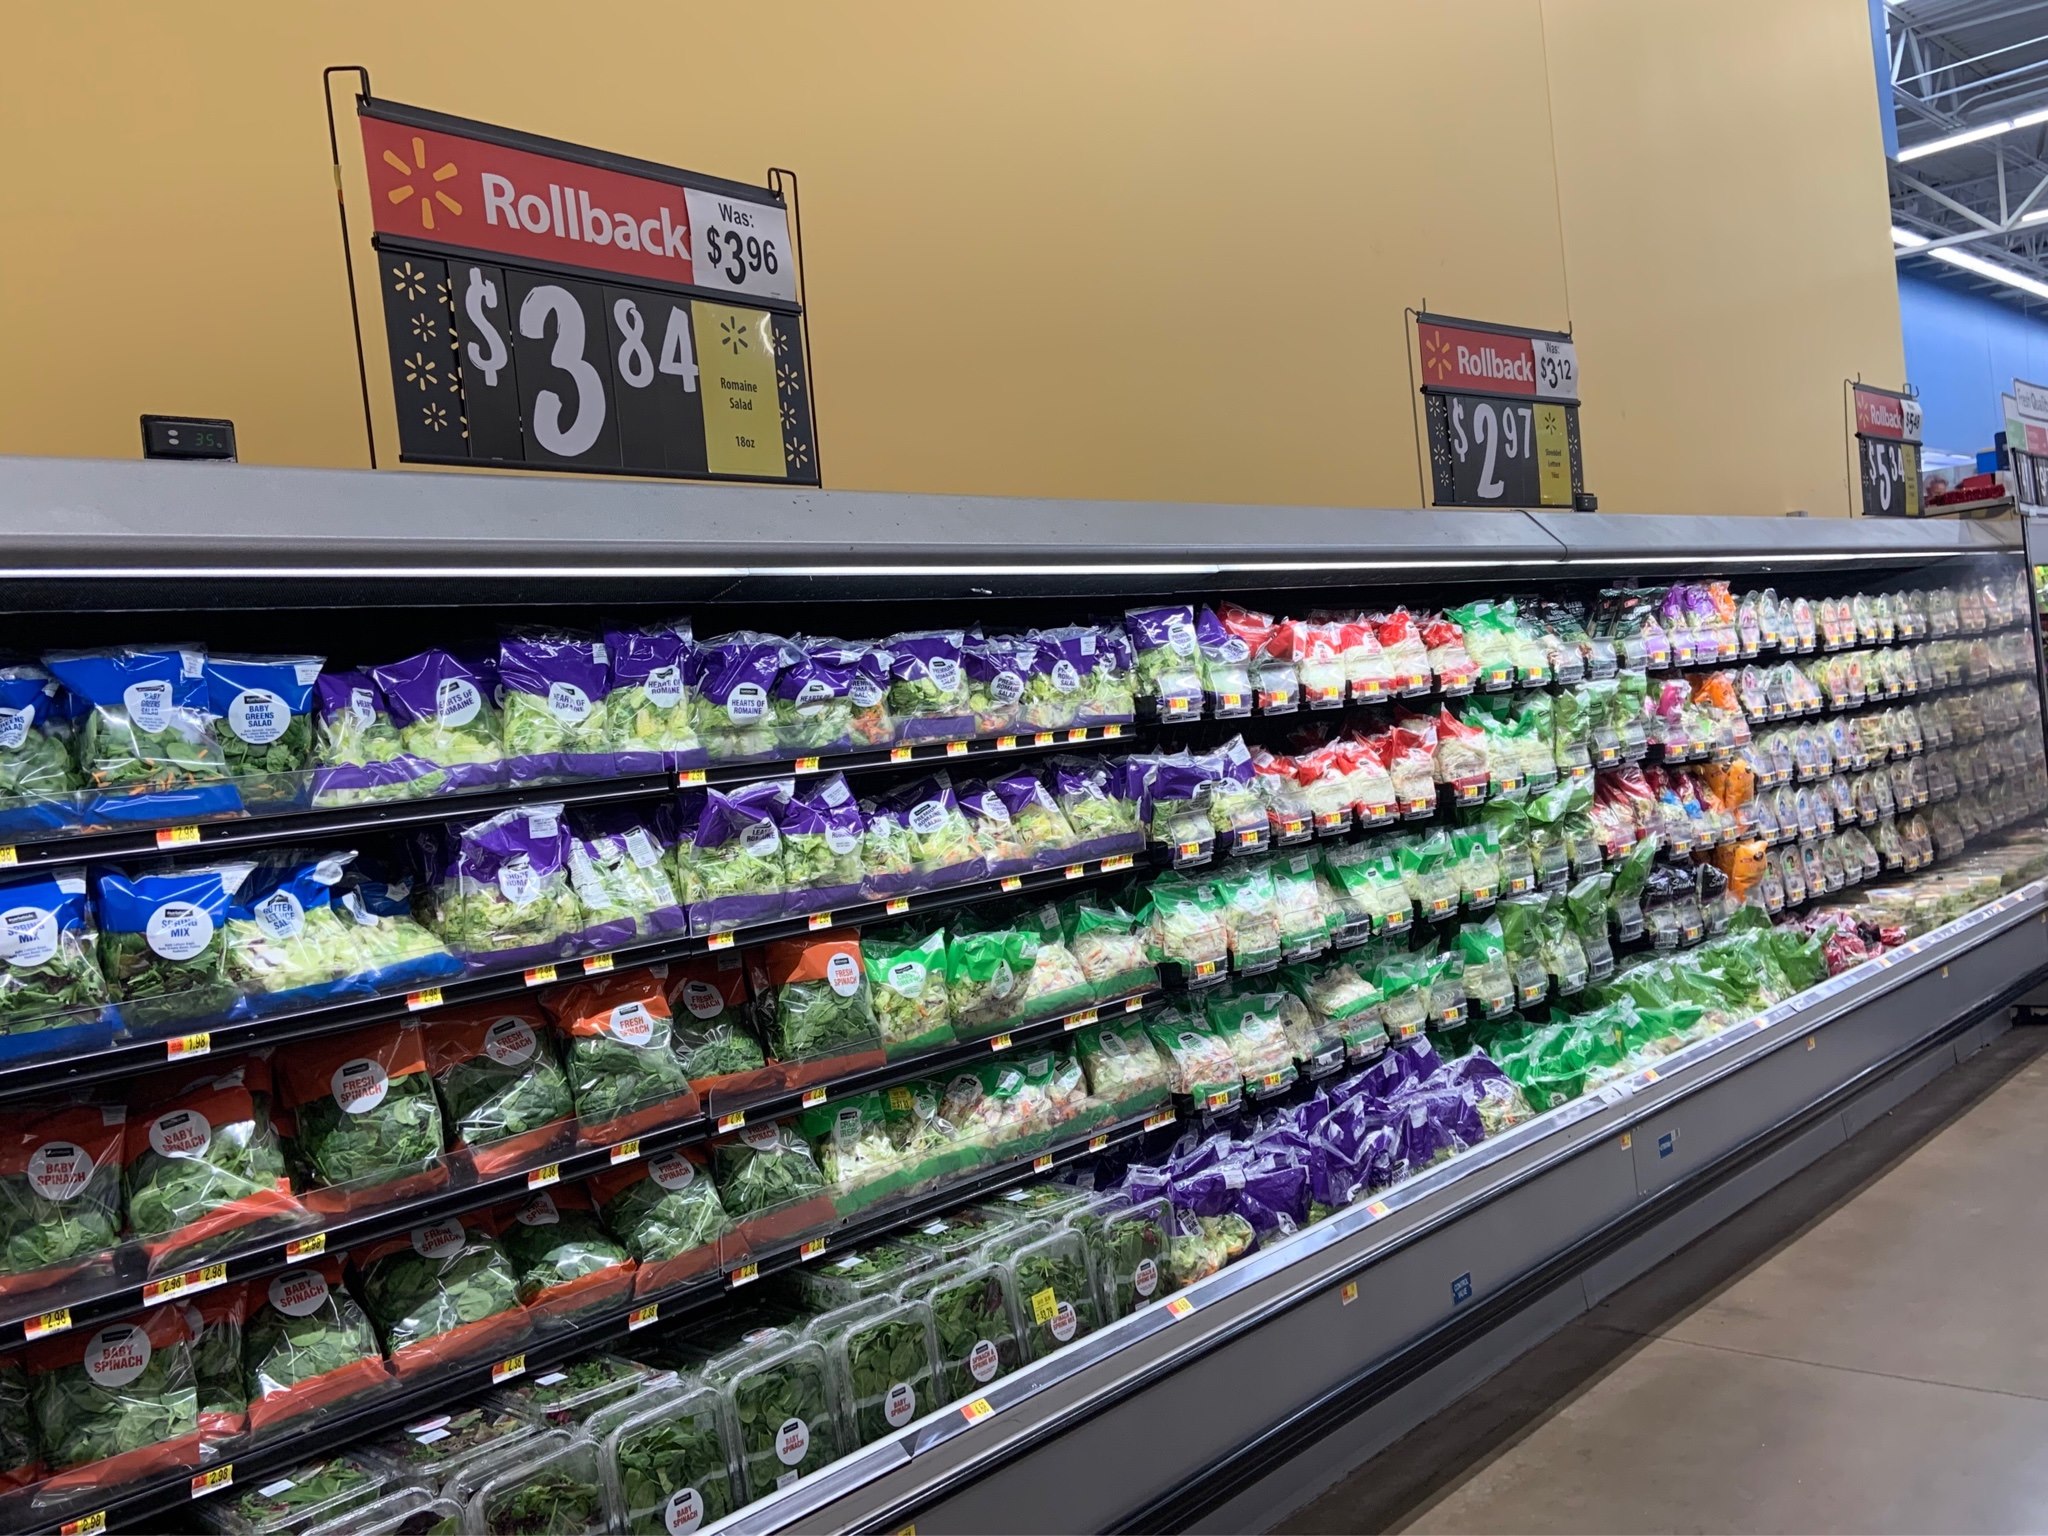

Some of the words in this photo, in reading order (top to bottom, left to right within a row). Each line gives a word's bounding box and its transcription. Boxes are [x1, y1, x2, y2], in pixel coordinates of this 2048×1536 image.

[481, 172, 692, 262] Rollback
[718, 202, 755, 229] Was:
[1457, 345, 1534, 382] Rollback
[720, 376, 758, 393] Romaine
[728, 397, 753, 412] Salad
[1870, 404, 1902, 429] Rollback
[735, 435, 755, 450] 18oz
[462, 689, 474, 700] OF
[249, 704, 269, 713] BABY
[731, 699, 756, 708] HEARTS
[757, 700, 765, 708] OF
[733, 706, 763, 715] ROMAINE
[245, 712, 275, 720] GREENS
[248, 719, 272, 728] SALAD
[179, 826, 194, 841] 2.98
[19, 932, 41, 943] MIX
[170, 928, 190, 938] MIX
[834, 968, 853, 977] FRESH
[834, 976, 857, 986] SPINACH
[690, 1000, 720, 1011] SPINACH
[691, 993, 714, 1003] FRESH
[619, 1016, 644, 1029] FRESH
[496, 1030, 524, 1046] FRESH
[620, 1024, 650, 1038] SPINACH
[189, 1034, 205, 1050] 1.98
[495, 1038, 533, 1059] SPINACH
[342, 1075, 375, 1090] FRESH
[340, 1085, 382, 1103] SPINACH
[164, 1127, 193, 1143] BABY
[748, 1130, 777, 1143] SPINACH
[162, 1135, 206, 1151] SPINACH
[46, 1161, 75, 1173] BABY
[658, 1161, 683, 1172] FRESH
[37, 1172, 86, 1186] SPINACH
[658, 1167, 691, 1183] SPINACH
[304, 1239, 321, 1252] 2.98
[422, 1233, 461, 1252] SPINACH
[204, 1268, 223, 1281] 2.98
[1137, 1269, 1151, 1279] SPINACH
[283, 1280, 312, 1297] BABY
[279, 1285, 325, 1308] SPINACH
[46, 1309, 66, 1328] 2.98
[102, 1344, 134, 1359] BABY
[972, 1351, 991, 1365] SPINACH
[94, 1354, 143, 1373] SPINACH
[972, 1358, 988, 1371] SPRING
[890, 1403, 911, 1418] SPINACH
[893, 1398, 907, 1409] BABY
[785, 1434, 799, 1444] BABY
[782, 1440, 805, 1455] SPINACH
[210, 1468, 228, 1484] 2.98
[676, 1504, 693, 1518] BABY
[82, 1514, 101, 1532] 2.98
[673, 1510, 698, 1528] SPINACH
